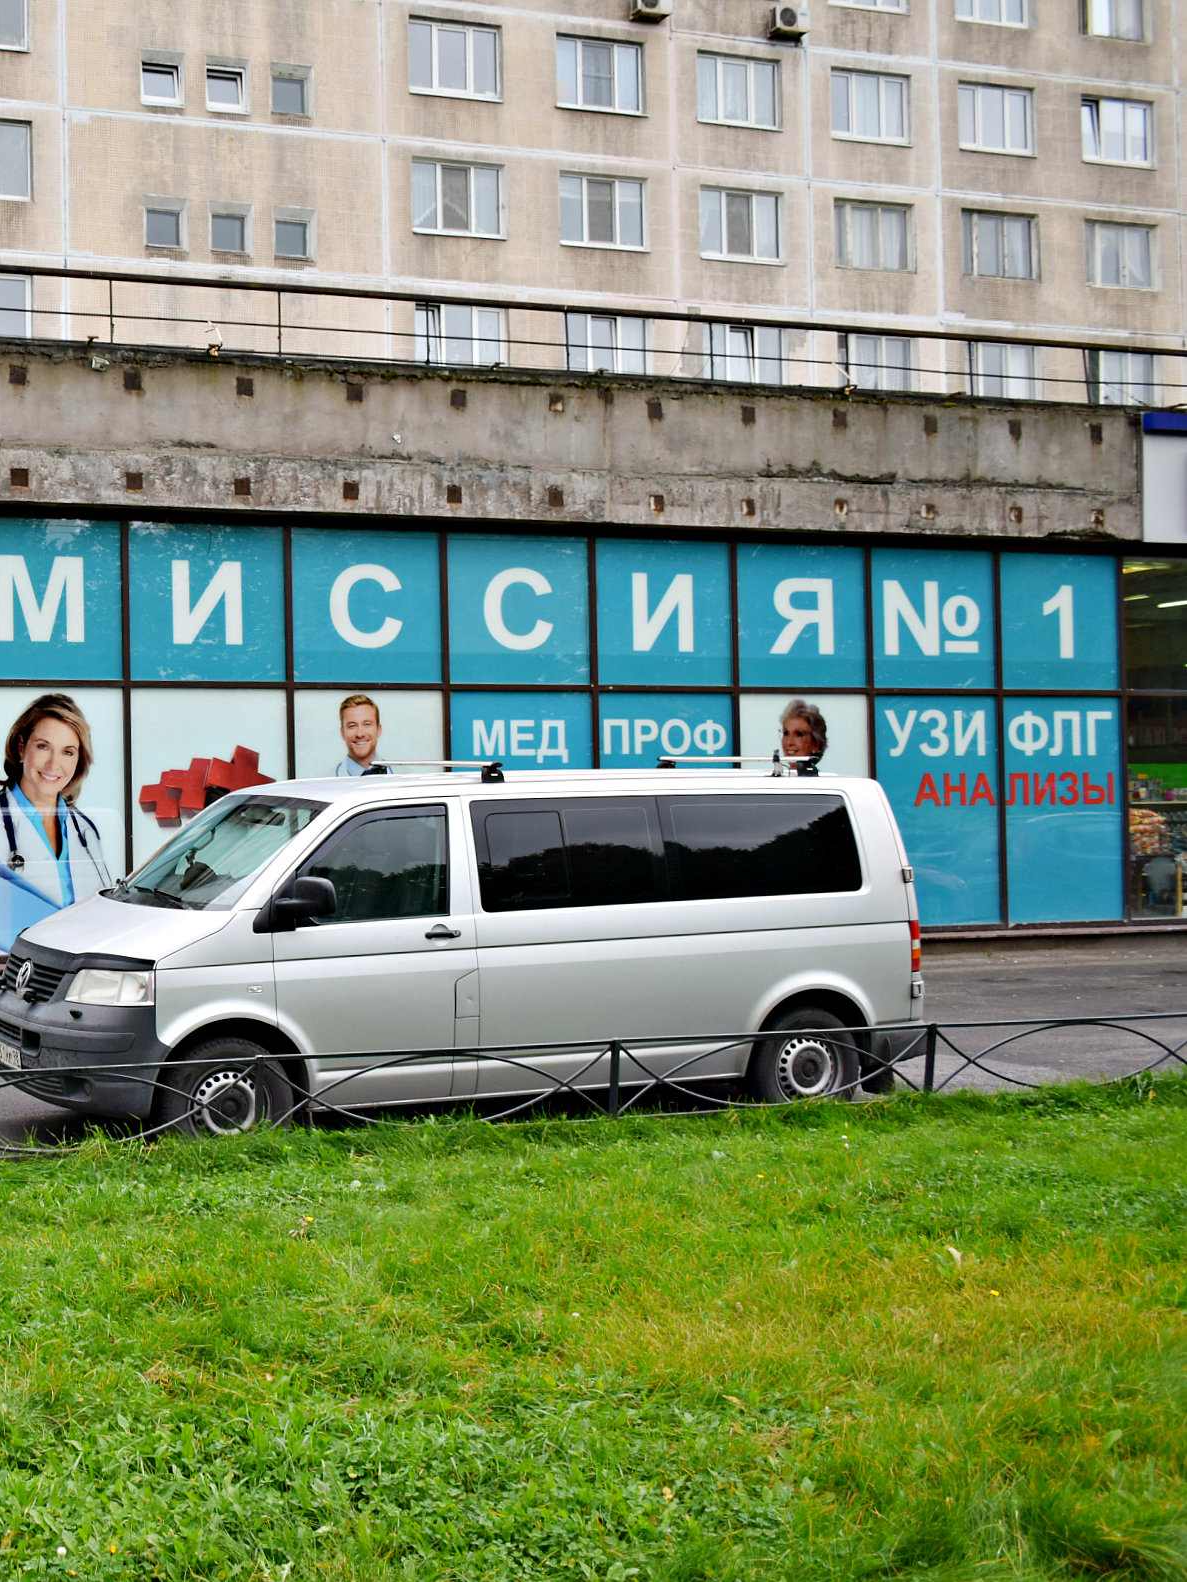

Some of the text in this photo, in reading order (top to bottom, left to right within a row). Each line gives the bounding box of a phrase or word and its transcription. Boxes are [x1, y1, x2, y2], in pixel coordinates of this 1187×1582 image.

[472, 718, 727, 764] МЕД ПРОФ
[884, 710, 986, 757] УЗИ
[1008, 710, 1112, 757] ФЛГ
[915, 772, 1114, 807] АНАЛИЗЫ
